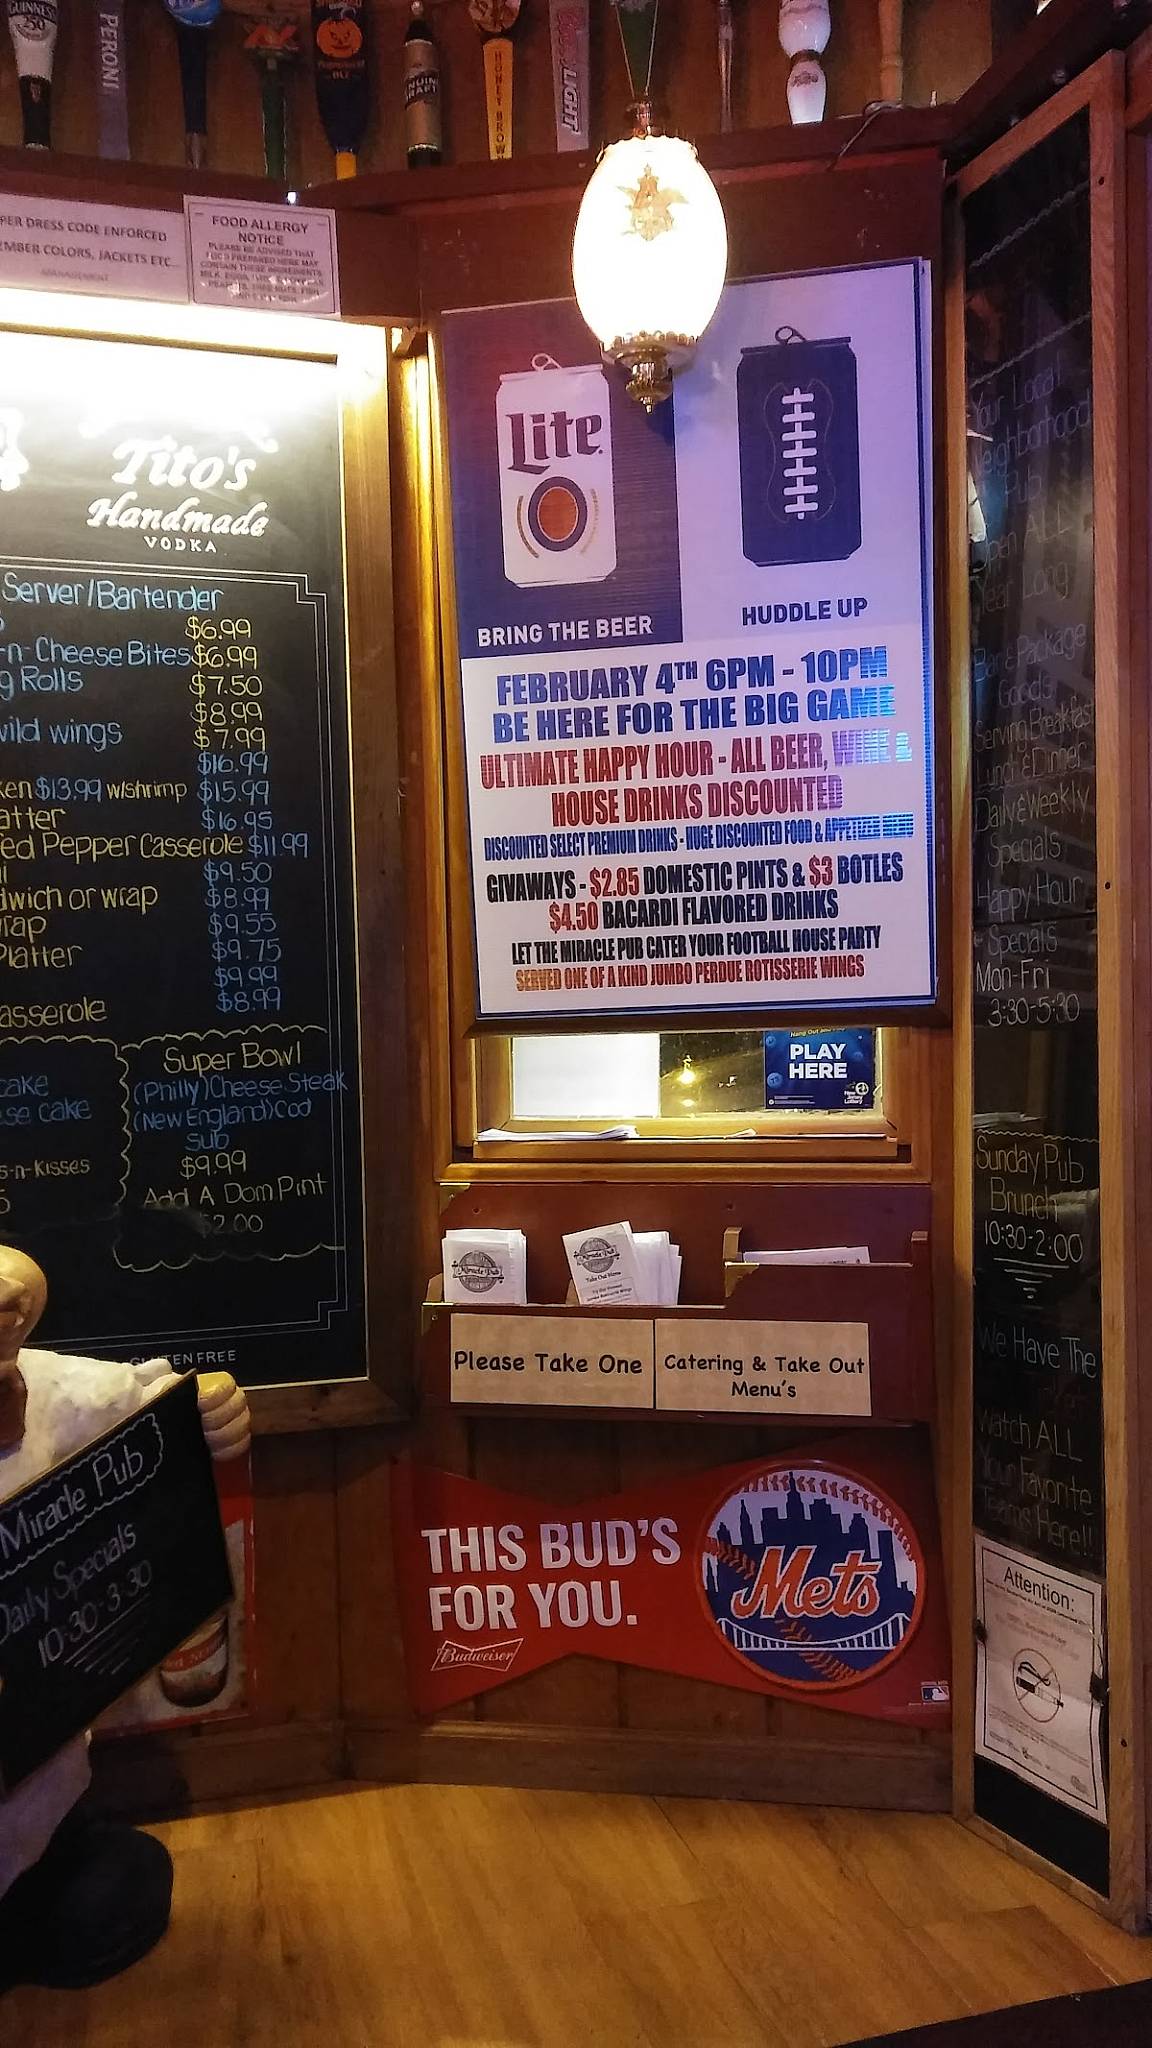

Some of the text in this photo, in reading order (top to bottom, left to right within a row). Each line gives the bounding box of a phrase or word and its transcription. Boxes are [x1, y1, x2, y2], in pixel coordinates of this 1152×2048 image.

[100, 13, 119, 89] PERONI
[561, 66, 582, 136] LIGHT
[26, 217, 168, 242] DRESS CODE ENFORCED
[212, 215, 309, 234] FOOD ALLERGY
[238, 232, 284, 246] NOTICE
[44, 244, 148, 265] COLORS, JACKETS
[505, 411, 604, 476] Lite
[112, 438, 257, 493] Tito's
[86, 491, 271, 538] Handmade
[144, 535, 217, 553] VODKA
[186, 615, 252, 641] $6.99
[742, 596, 869, 627] HUDDLE UP
[477, 614, 654, 648] BRING THE BEER
[127, 640, 258, 671] Bites $6.99
[21, 665, 84, 693] Rolls
[189, 670, 264, 698] $7.50
[496, 645, 888, 706] FEBRUARY 4TH 6PM 10PM
[190, 699, 264, 727] $8.99
[493, 683, 897, 744] BE HERE FOR THE BIG GAME
[50, 717, 123, 753] wings
[193, 726, 267, 752] $7.99
[198, 749, 270, 776] $16.99
[480, 732, 828, 790] ULTIMATE HAPPY HOUR ALL BEER,
[35, 776, 271, 806] $13.99 $15.99
[551, 774, 843, 827] HOUSE DRINKS DISCOUNTED
[1026, 780, 1091, 824] Weekly
[201, 805, 273, 833] $16.95
[42, 831, 310, 865] Pepper Casserole $11.99
[484, 834, 548, 862] DISCOUNTED
[549, 831, 586, 859] SELECT
[587, 829, 639, 856] PREMIUM
[638, 826, 678, 853] DRINKS
[685, 824, 714, 850] HUGE
[715, 820, 783, 849] DISCOUNTED
[784, 818, 813, 845] FOOD
[987, 826, 1062, 873] Specials
[203, 858, 273, 887] $9.50
[486, 851, 904, 904] GIVAWAYS $2.85 DOMESTIC PINTS & $3 BOTLES
[68, 885, 271, 915] or wrap $8.99
[549, 888, 839, 934] $4.50 BACARDI FLAVORED DRINKS
[977, 872, 1084, 922] Happy Hour
[207, 912, 278, 941] $9.55
[211, 938, 282, 963] $9.75
[511, 925, 881, 965] LET THE MIRACLE PUB CATER YOUR FOOTBALL HOUSE PARTY
[515, 954, 865, 992] SERVED ONE OF A KIND JUMBO PERDUE ROTISSERIE WINGS
[976, 957, 1050, 993] Mon-Fri
[215, 986, 282, 1014] $8.99
[987, 992, 1081, 1028] 3:30-5:30
[164, 1041, 302, 1075] Super Bowl
[790, 1043, 846, 1060] PLAY
[284, 1070, 348, 1094] Steak
[789, 1062, 848, 1079] HERE
[179, 1150, 247, 1181] $9.99
[976, 1135, 1084, 1185] Sunday Pub
[143, 1172, 329, 1208] Add A Dom Pint
[990, 1176, 1059, 1223] Brunch
[984, 1220, 1084, 1263] 10:30-2:00
[130, 1350, 237, 1367] GLTEN FREE
[454, 1350, 643, 1375] Please Take One
[664, 1354, 865, 1376] Catering & Take Out
[1012, 1325, 1097, 1379] Have The
[731, 1379, 797, 1399] Menu's
[0, 1445, 144, 1560] Miracle Pub
[53, 1523, 137, 1600] Specials
[421, 1518, 682, 1574] THIS BUD'S
[731, 1545, 883, 1619] Mets
[1003, 1566, 1075, 1613] Attention:
[428, 1579, 638, 1632] FOR YOU.
[440, 1644, 515, 1666] Budweiser
